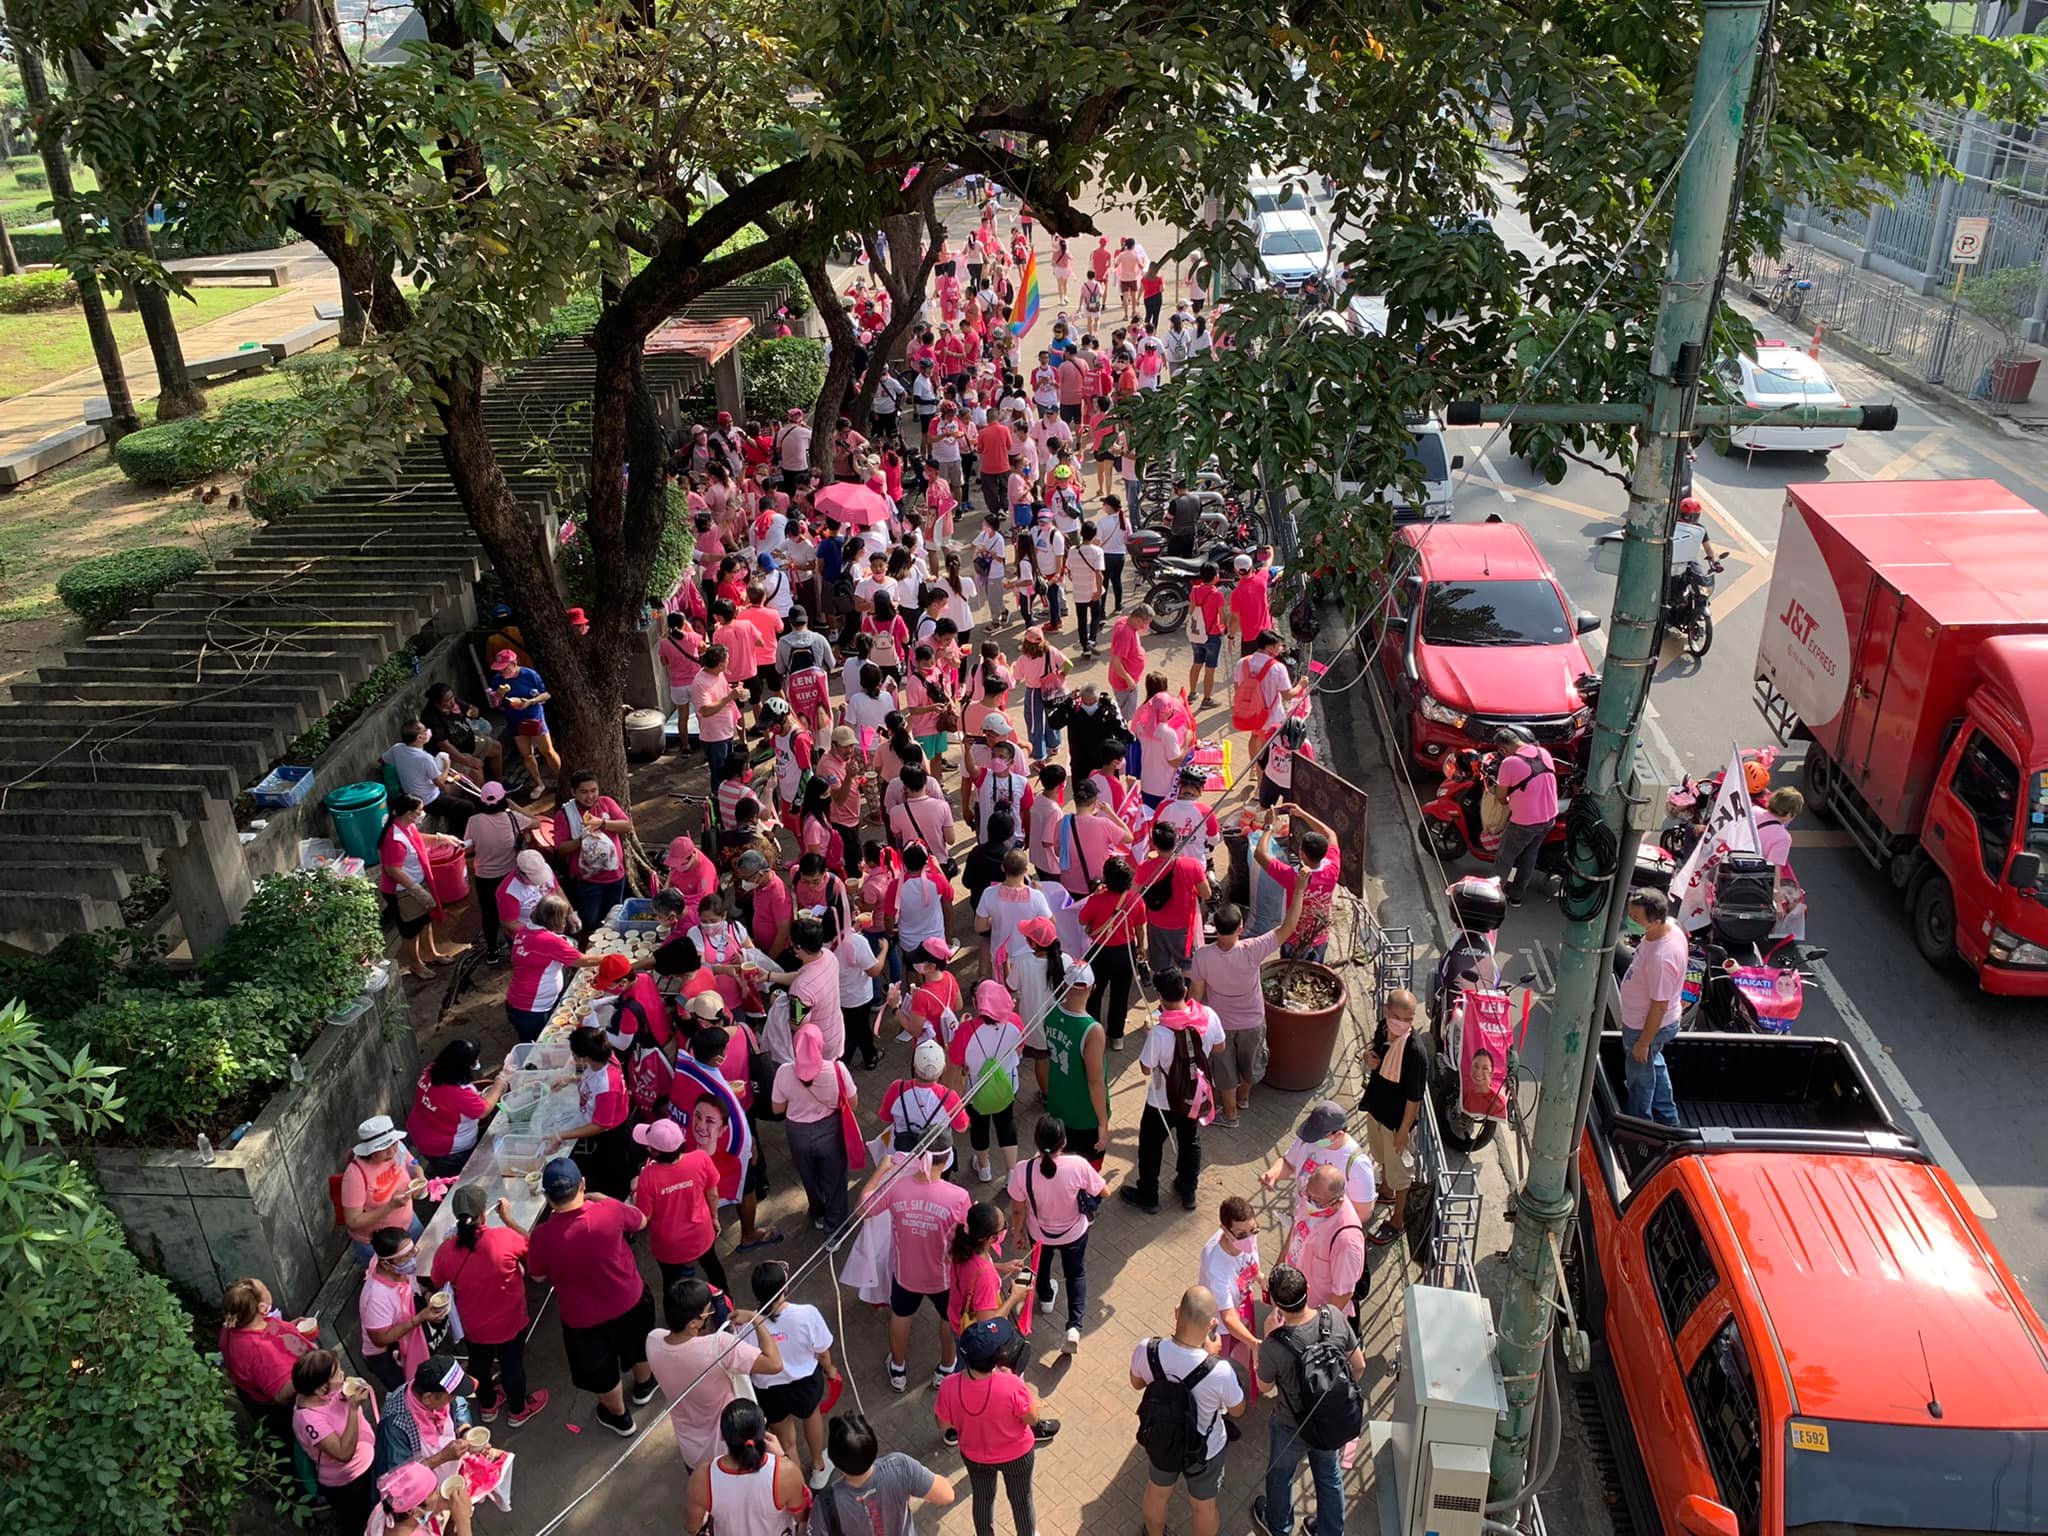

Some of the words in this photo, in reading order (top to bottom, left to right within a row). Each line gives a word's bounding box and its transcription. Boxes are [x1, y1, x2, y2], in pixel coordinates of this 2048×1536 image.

[1780, 598, 1820, 645] J&T
[1807, 640, 1837, 677] EXPRESS
[792, 675, 817, 687] LENI
[1734, 977, 1772, 988] MAKATI
[1045, 1024, 1073, 1050] PIERCE
[305, 1424, 319, 1440] 8
